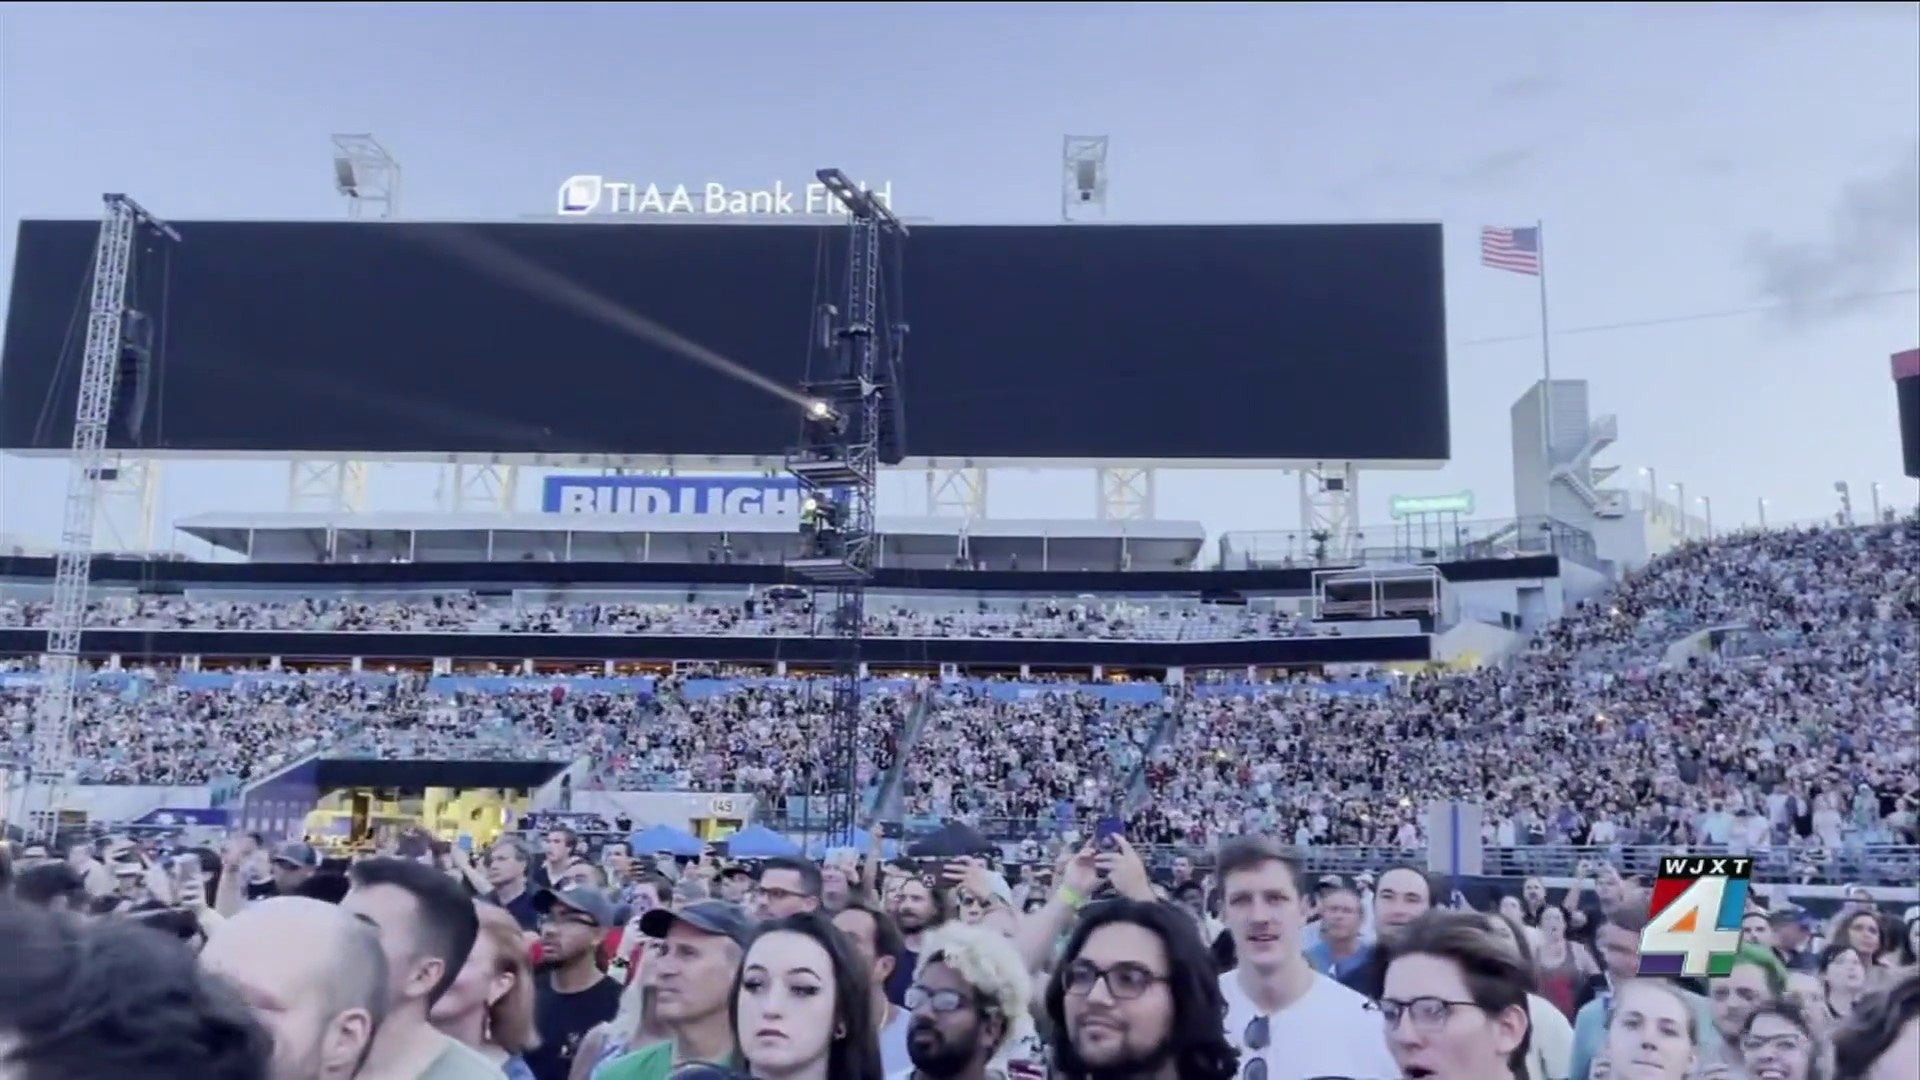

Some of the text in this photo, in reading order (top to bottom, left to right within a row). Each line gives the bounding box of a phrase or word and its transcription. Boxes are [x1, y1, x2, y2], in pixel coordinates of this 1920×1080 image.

[604, 182, 694, 214] TIAA
[705, 181, 793, 214] Bank
[560, 486, 832, 514] BUD LIGH
